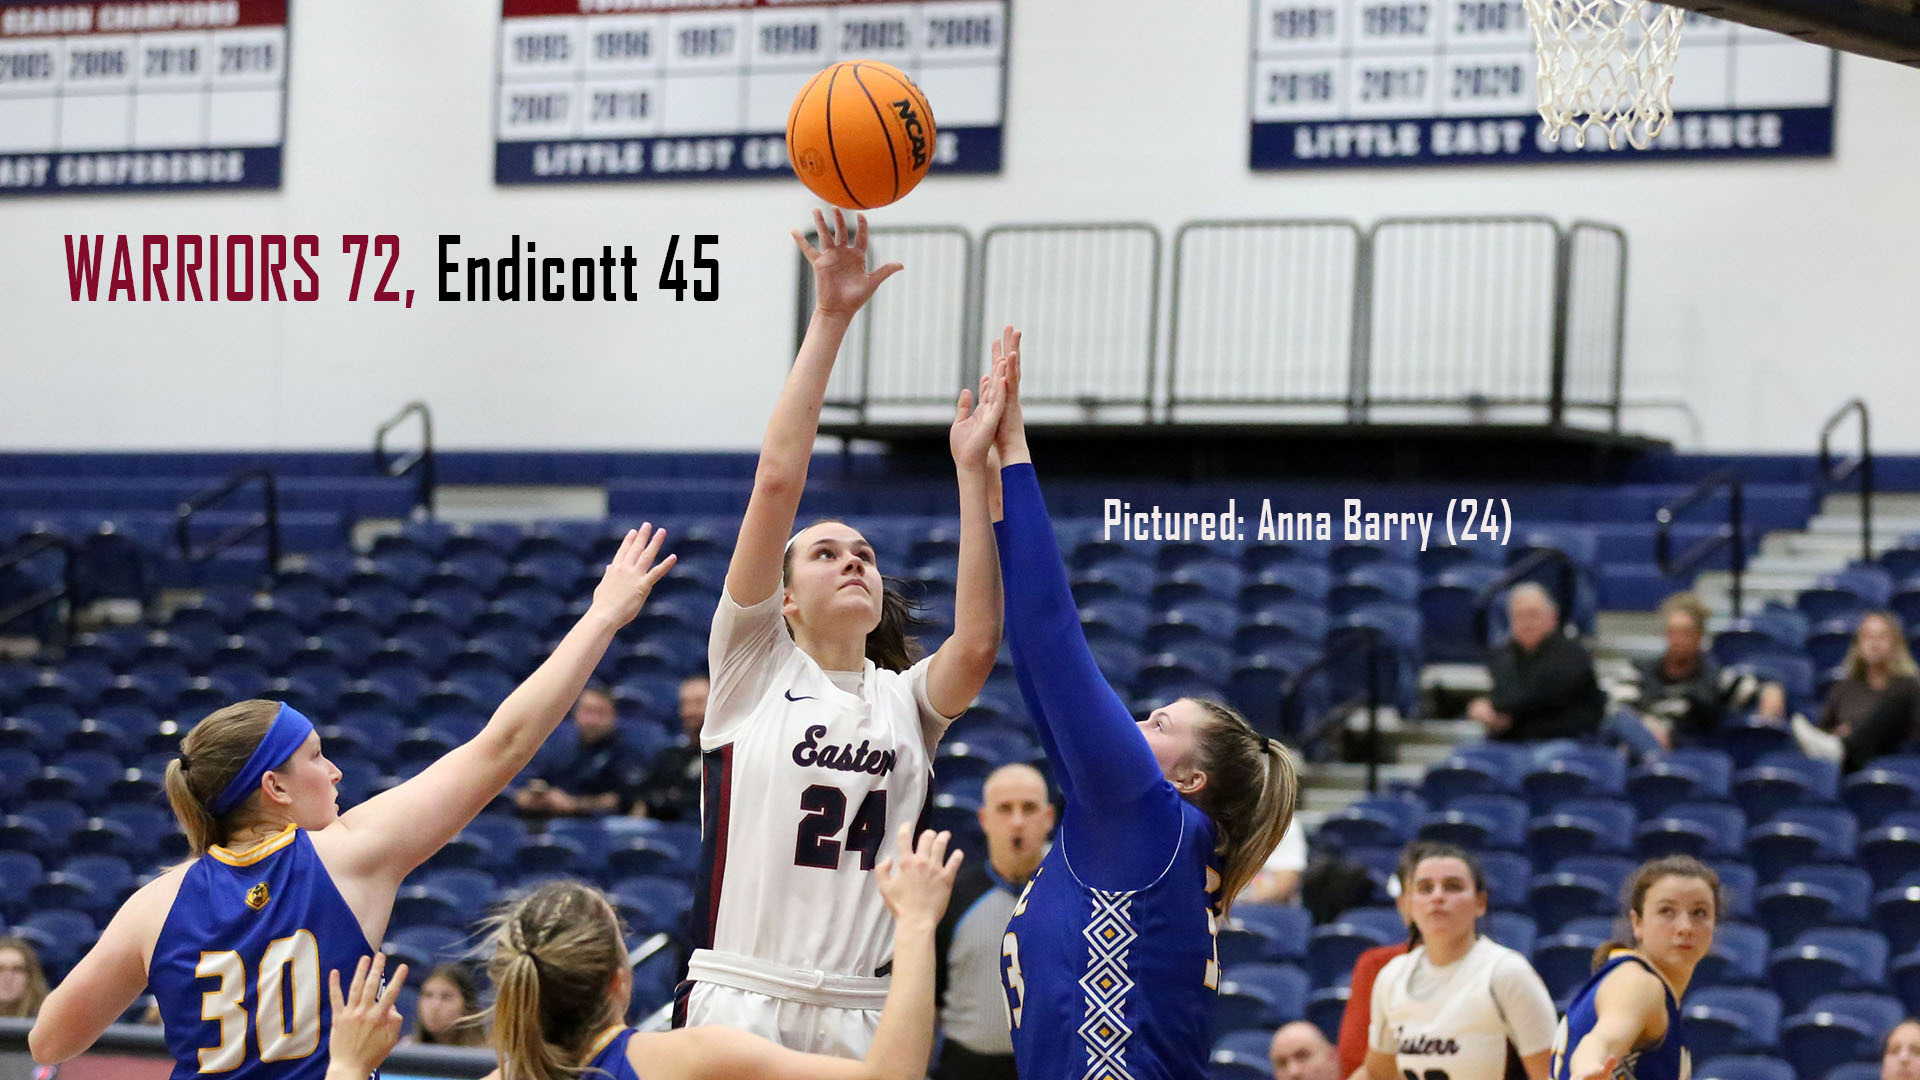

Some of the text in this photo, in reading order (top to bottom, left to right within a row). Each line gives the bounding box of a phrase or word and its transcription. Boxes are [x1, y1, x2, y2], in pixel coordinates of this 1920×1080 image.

[3, 1, 240, 35] SEASON CHAMPIONS
[1363, 5, 1427, 36] 1992
[1359, 68, 1427, 101] 2017
[892, 98, 927, 172] NCAA
[1294, 122, 1421, 159] LITTLE
[1430, 119, 1525, 155] EAST
[57, 151, 245, 186] CONFERENCE
[533, 143, 645, 176] LITTLE
[651, 139, 736, 172] EAST
[794, 784, 888, 871] 24
[195, 928, 322, 1074] 30
[1000, 931, 1026, 1033] 3
